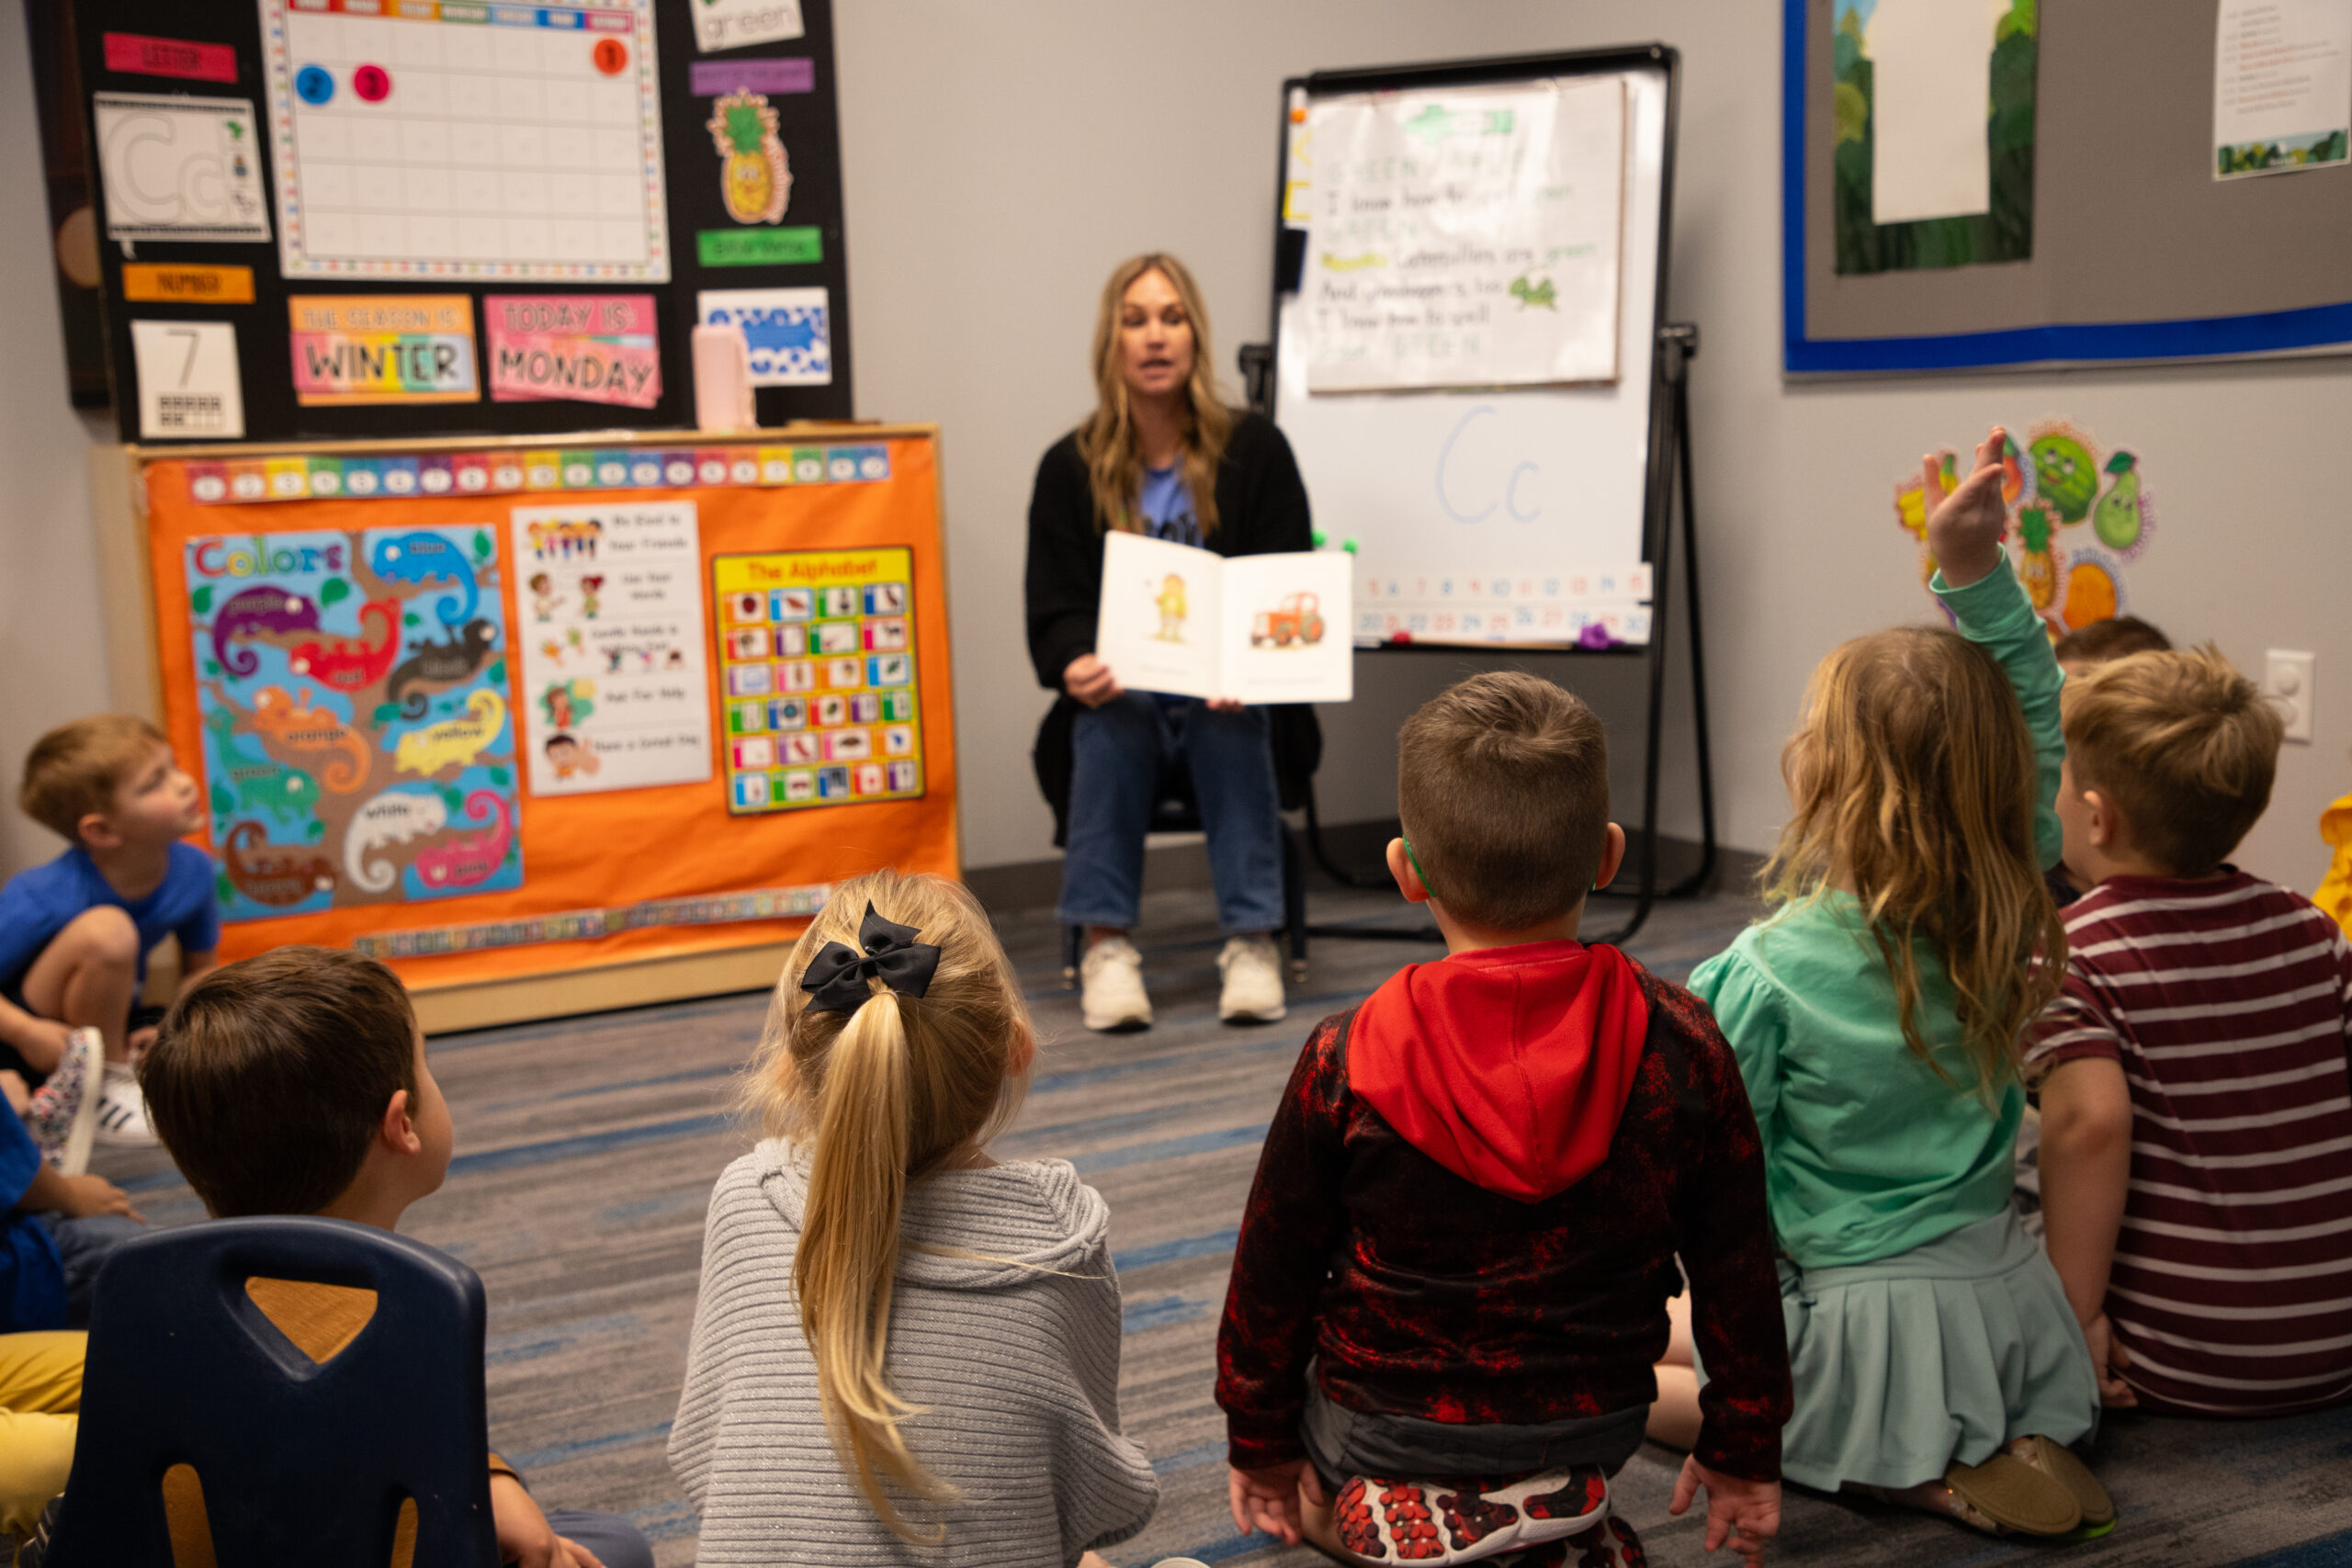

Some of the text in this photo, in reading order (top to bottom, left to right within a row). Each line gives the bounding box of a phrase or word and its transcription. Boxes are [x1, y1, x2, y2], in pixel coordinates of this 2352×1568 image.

[705, 6, 795, 50] green
[1504, 247, 1533, 264] are
[304, 308, 458, 329] THE SEASON IS
[504, 303, 631, 332] TODAY IS
[166, 329, 201, 389] 7
[307, 343, 459, 381] WINTER
[499, 348, 654, 393] MONDAY
[1436, 404, 1542, 524] Cc
[194, 534, 343, 578] Colors
[747, 558, 878, 582] The Alphabet
[286, 728, 348, 743] orange
[430, 725, 485, 745] yellow
[365, 802, 411, 819] white
